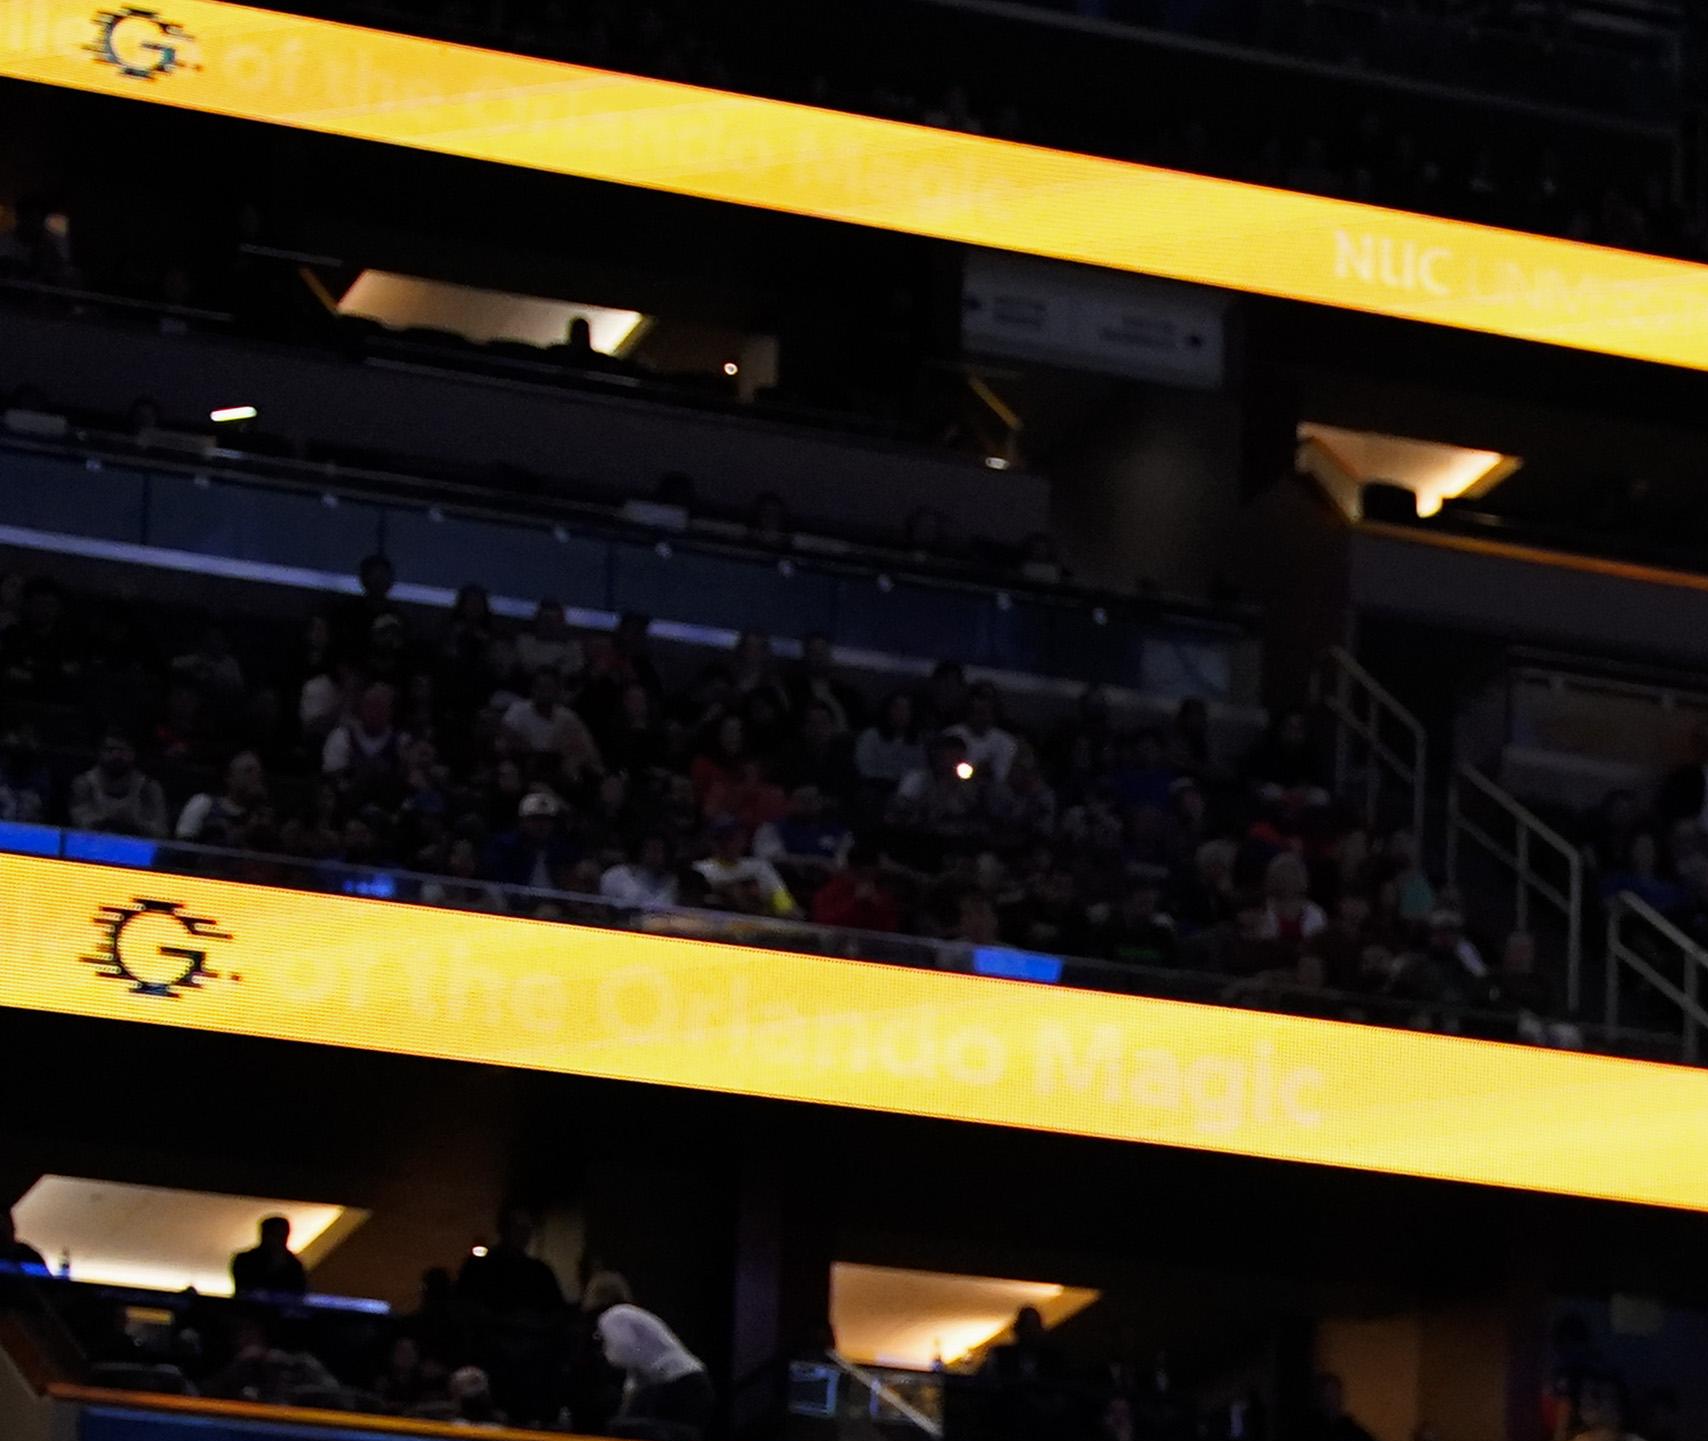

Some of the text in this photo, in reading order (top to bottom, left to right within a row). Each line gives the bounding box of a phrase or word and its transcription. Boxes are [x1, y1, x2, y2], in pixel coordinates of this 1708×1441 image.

[1331, 229, 1454, 297] NUC
[406, 945, 568, 1034] the
[599, 963, 1004, 1086] Orlando
[1032, 1020, 1326, 1133] Magic
